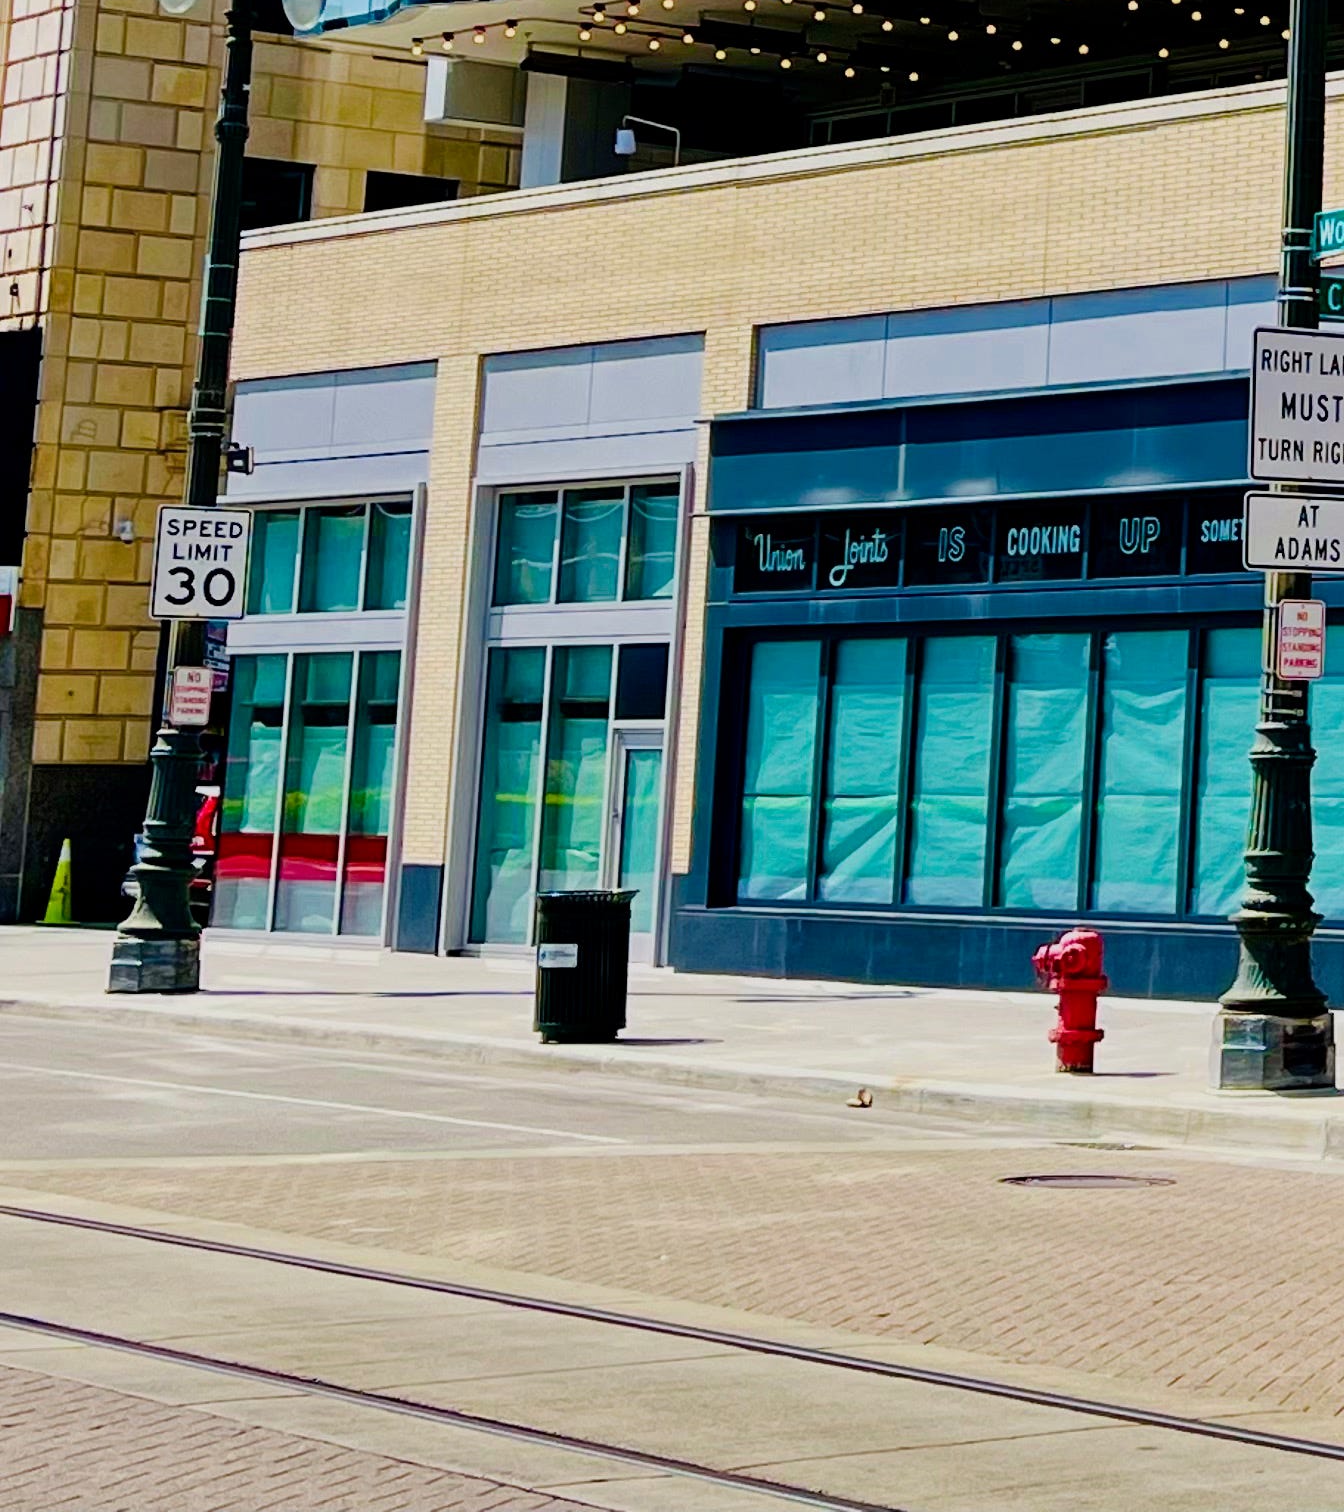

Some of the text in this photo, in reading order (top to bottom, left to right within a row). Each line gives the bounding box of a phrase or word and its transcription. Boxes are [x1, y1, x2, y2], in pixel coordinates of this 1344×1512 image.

[1261, 349, 1313, 374] RIGHT
[1281, 392, 1344, 423] MUST
[1258, 438, 1304, 462] TURN
[166, 518, 243, 539] SPEED
[1298, 505, 1320, 529] AT
[172, 542, 233, 562] LIMIT
[754, 533, 806, 572] Union
[829, 528, 889, 587] Joints
[938, 526, 966, 563] IS
[1007, 524, 1081, 557] COOKING
[1119, 517, 1161, 555] UP
[1274, 536, 1341, 562] ADAMS
[164, 566, 236, 607] 30
